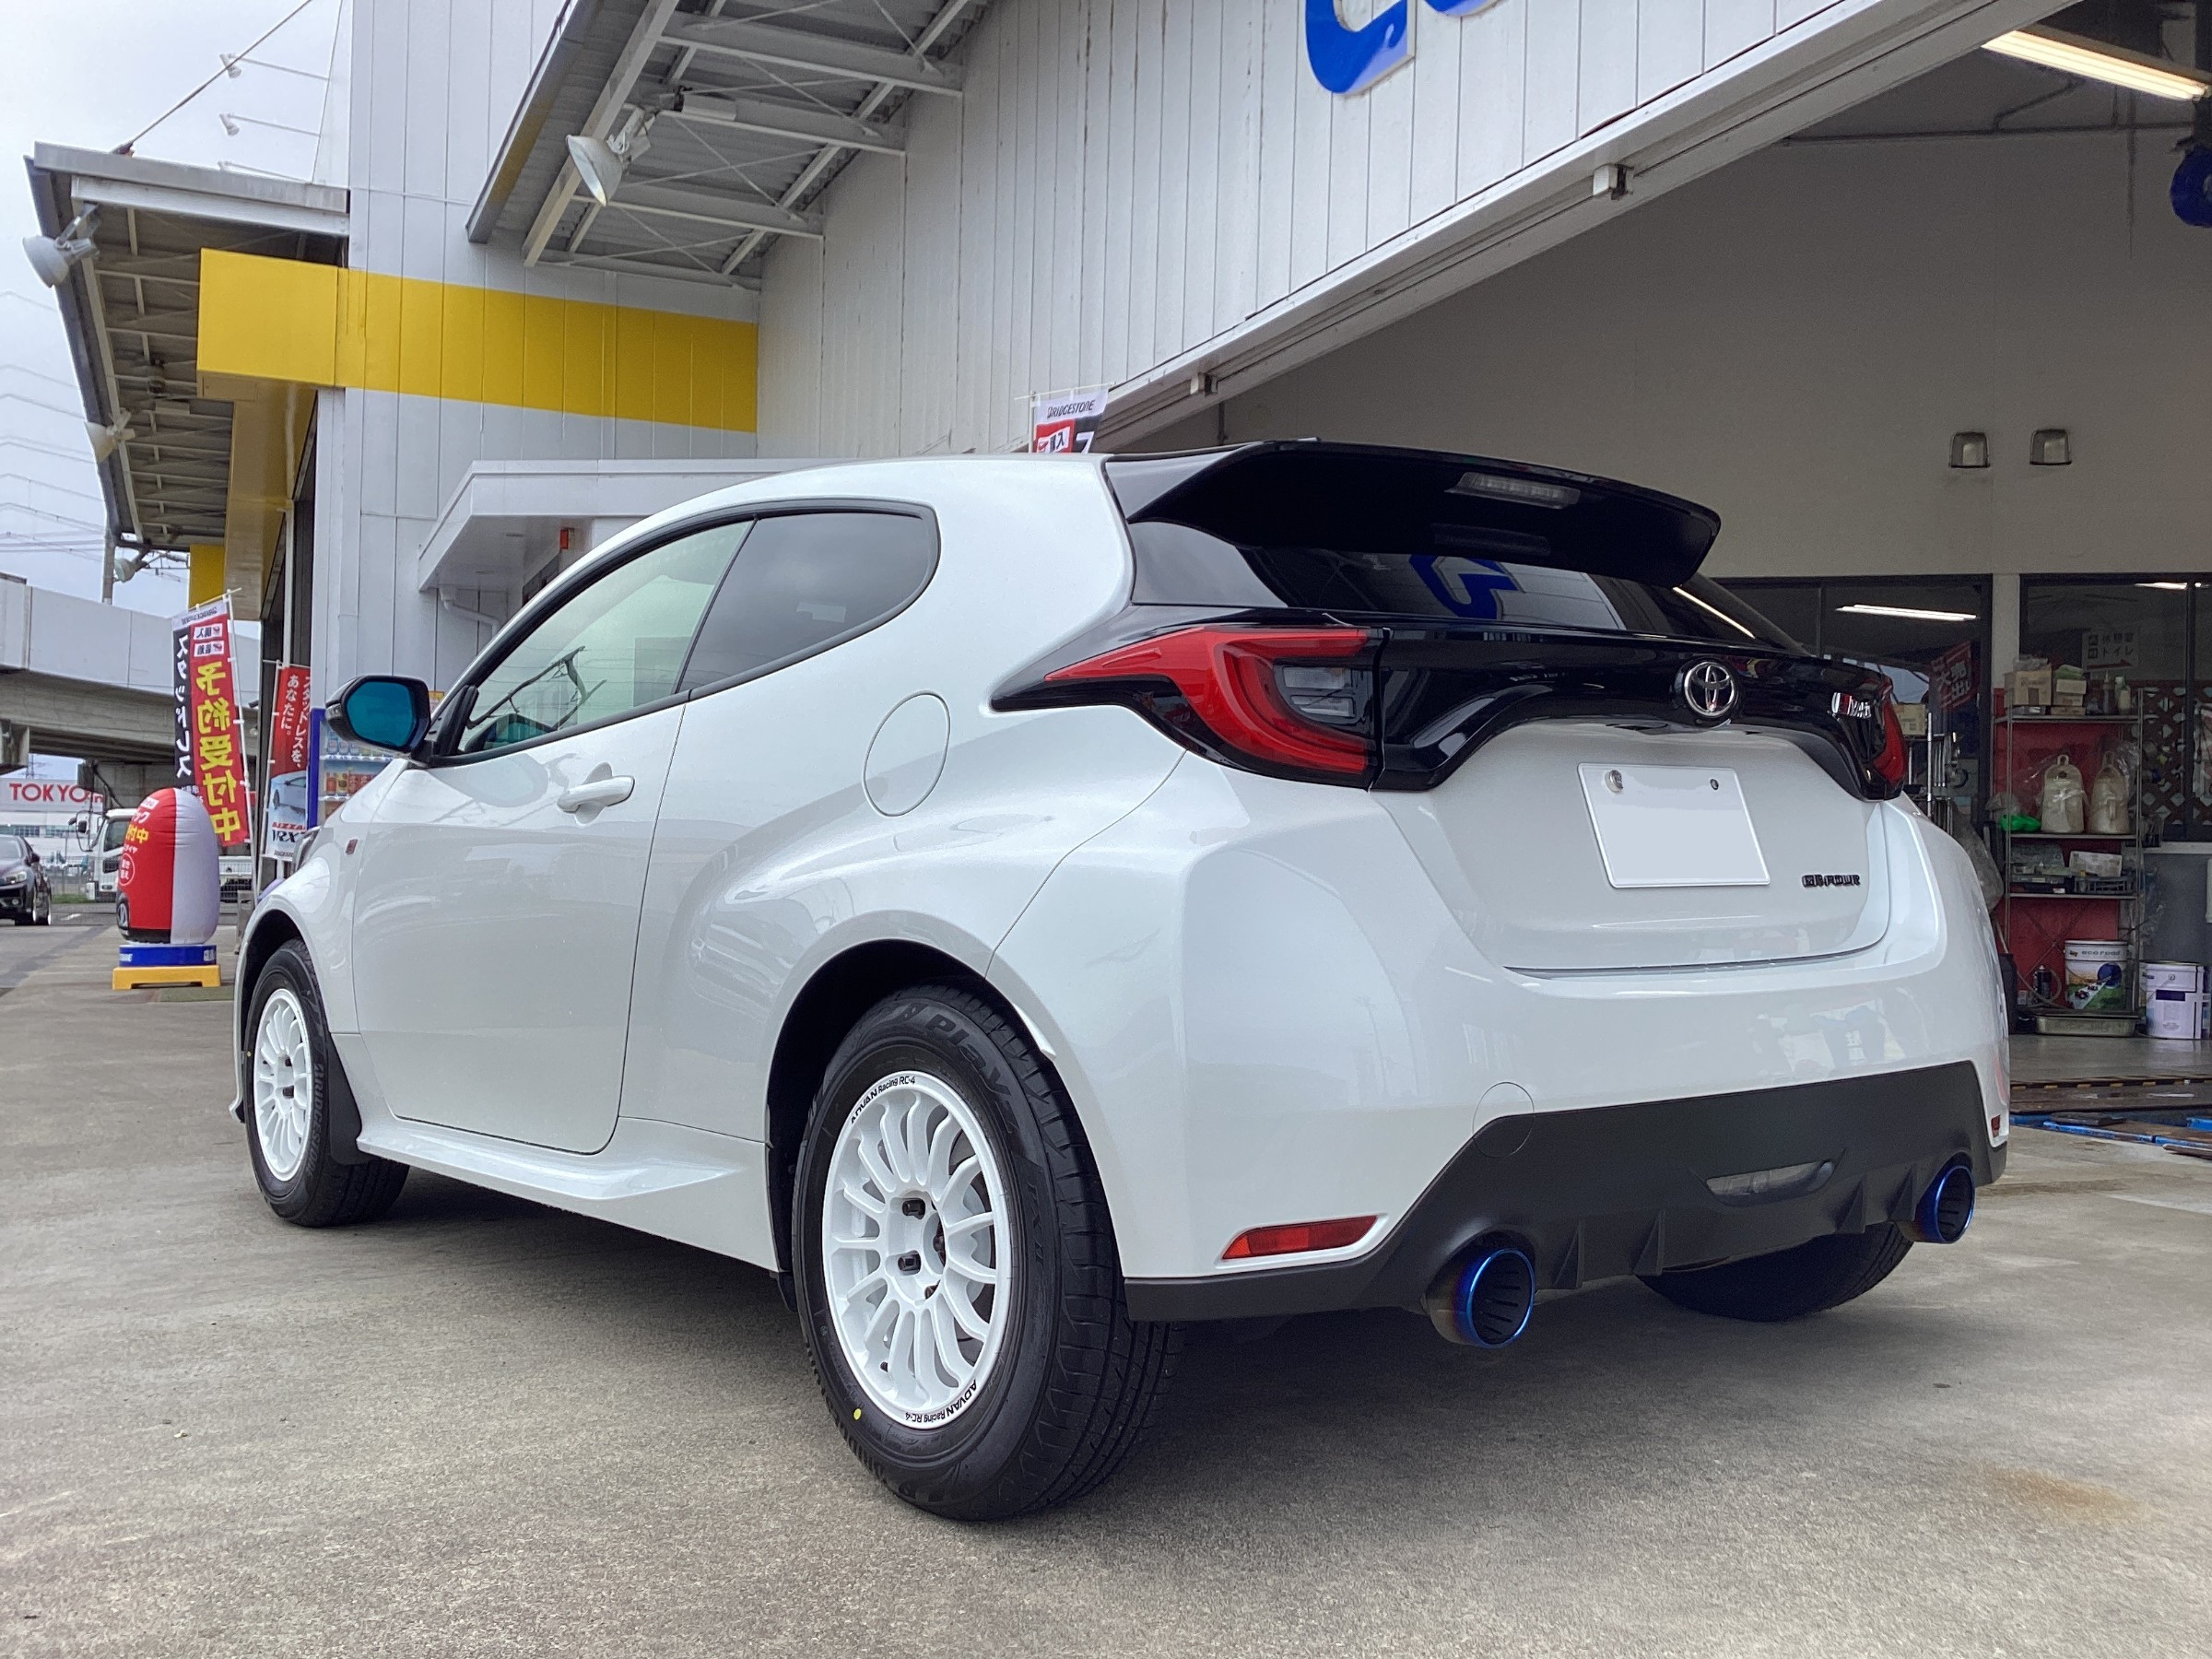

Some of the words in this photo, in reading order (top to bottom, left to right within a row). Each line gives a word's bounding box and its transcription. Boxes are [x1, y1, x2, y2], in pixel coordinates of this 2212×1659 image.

[1047, 400, 1095, 418] BRIDGESTONE
[9, 783, 89, 803] TOKYO
[852, 1088, 877, 1124] ADVAN
[877, 1078, 899, 1093] Racing
[947, 1379, 977, 1417] ADVAN
[924, 1409, 946, 1422] Racing
